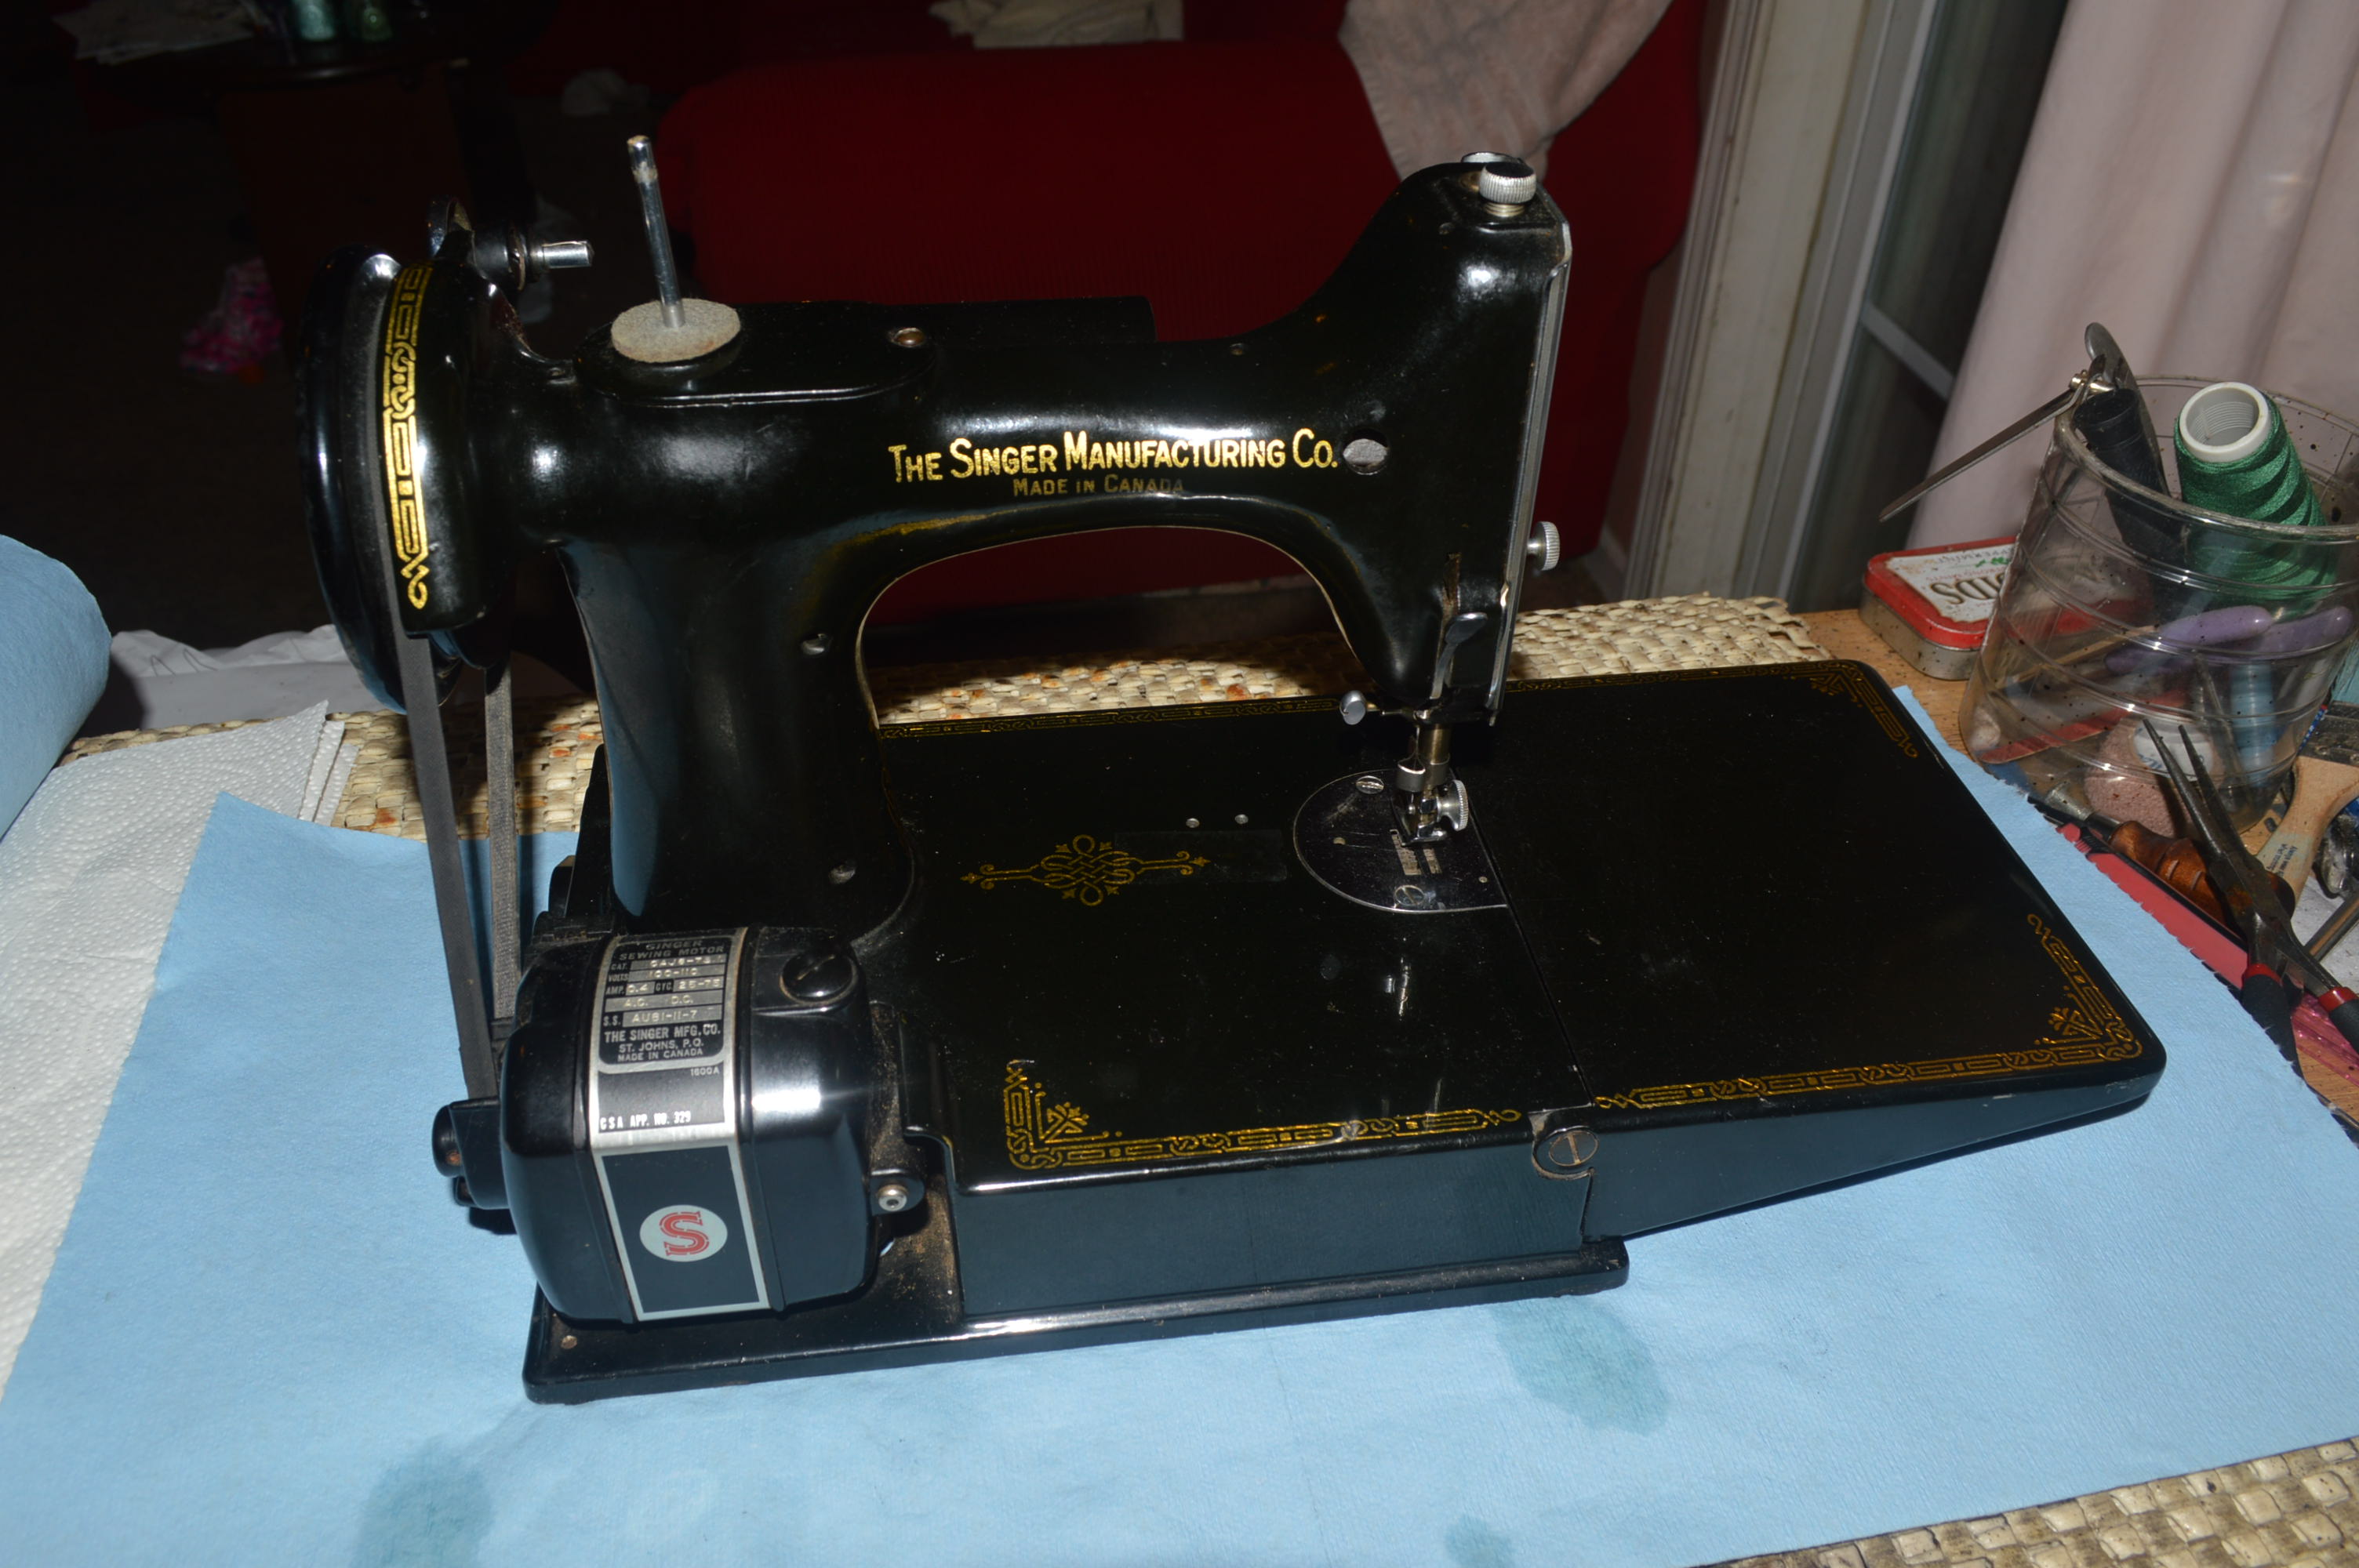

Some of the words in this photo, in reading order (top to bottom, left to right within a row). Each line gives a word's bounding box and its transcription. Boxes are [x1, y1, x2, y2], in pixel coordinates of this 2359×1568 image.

[888, 444, 943, 483] THE
[949, 437, 1058, 479] SINGER
[1063, 430, 1286, 470] MANUFACTURING
[1012, 477, 1068, 497] MADE
[1075, 480, 1096, 494] IN
[620, 950, 671, 960] SEWING
[678, 946, 724, 956] MOTOR
[646, 941, 703, 950] SINGER
[604, 1030, 627, 1043] THE
[629, 1027, 669, 1041] SINGER
[619, 1043, 635, 1053] ST.
[682, 1038, 704, 1048] P.Q.
[649, 1051, 659, 1060] IN
[663, 1048, 703, 1058] CANADA
[630, 1113, 650, 1128] APP.
[674, 1110, 691, 1123] 329
[659, 1211, 710, 1256] S
